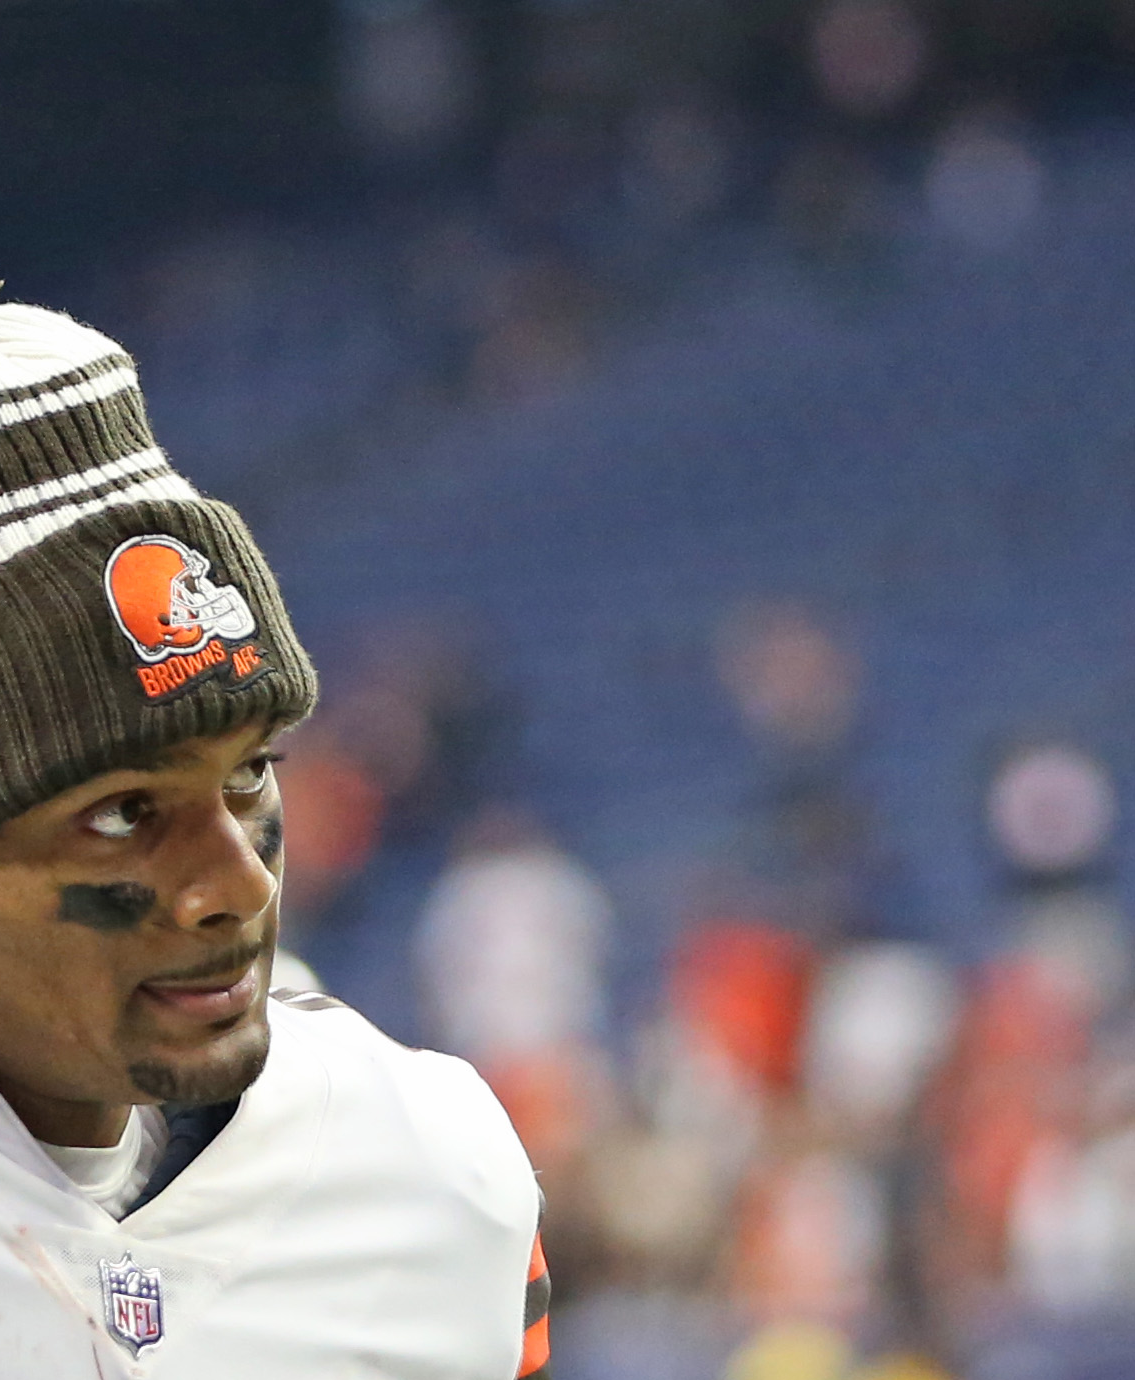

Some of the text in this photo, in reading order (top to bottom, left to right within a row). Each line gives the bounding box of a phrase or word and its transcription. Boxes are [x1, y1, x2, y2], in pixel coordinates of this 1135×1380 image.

[137, 640, 261, 698] BROWNS AFC
[116, 1296, 158, 1338] NFL
